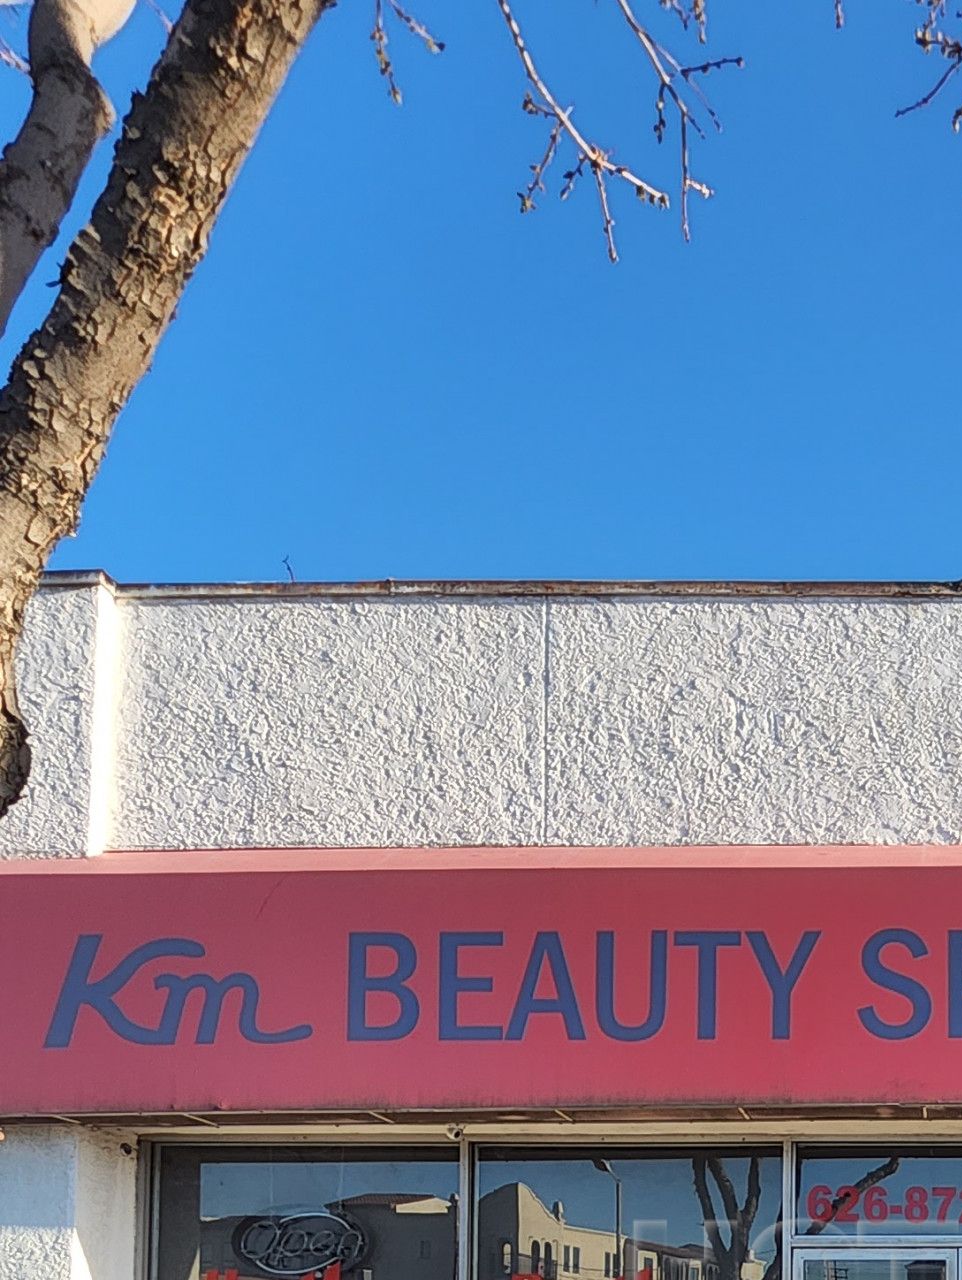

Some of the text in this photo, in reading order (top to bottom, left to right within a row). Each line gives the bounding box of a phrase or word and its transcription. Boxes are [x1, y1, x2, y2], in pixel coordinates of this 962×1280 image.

[43, 933, 313, 1049] Km
[346, 929, 823, 1043] BEAUTY
[241, 1221, 365, 1268] Open
